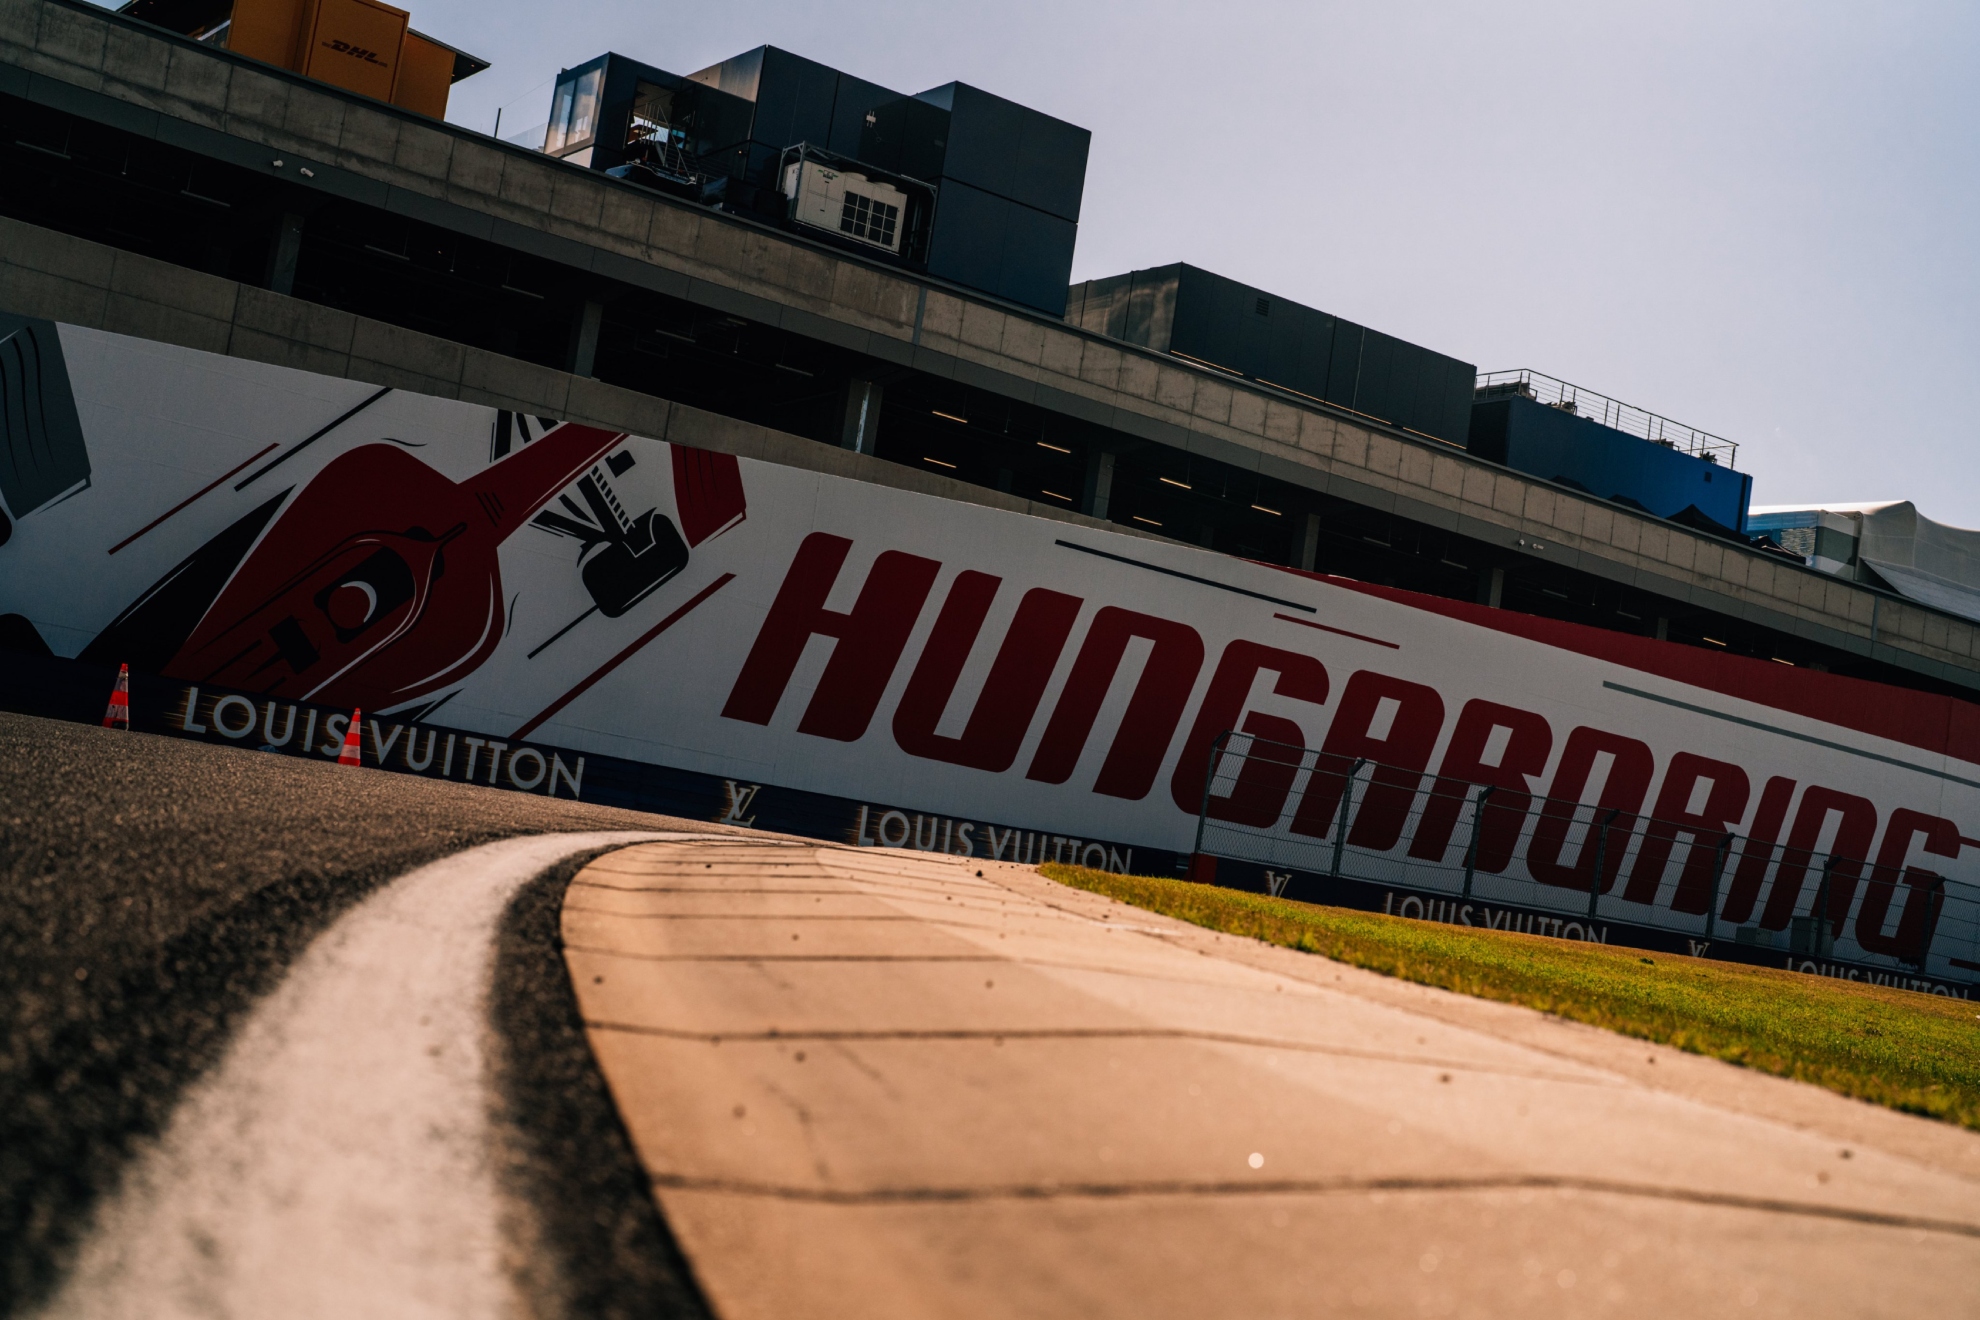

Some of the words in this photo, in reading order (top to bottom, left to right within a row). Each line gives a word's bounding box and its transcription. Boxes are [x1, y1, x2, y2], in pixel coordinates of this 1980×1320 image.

[331, 39, 378, 64] DHL
[182, 686, 350, 757] LOUIS
[369, 718, 585, 800] VUITTON
[858, 805, 976, 858] LOUIS
[988, 825, 1133, 875] VUITTON
